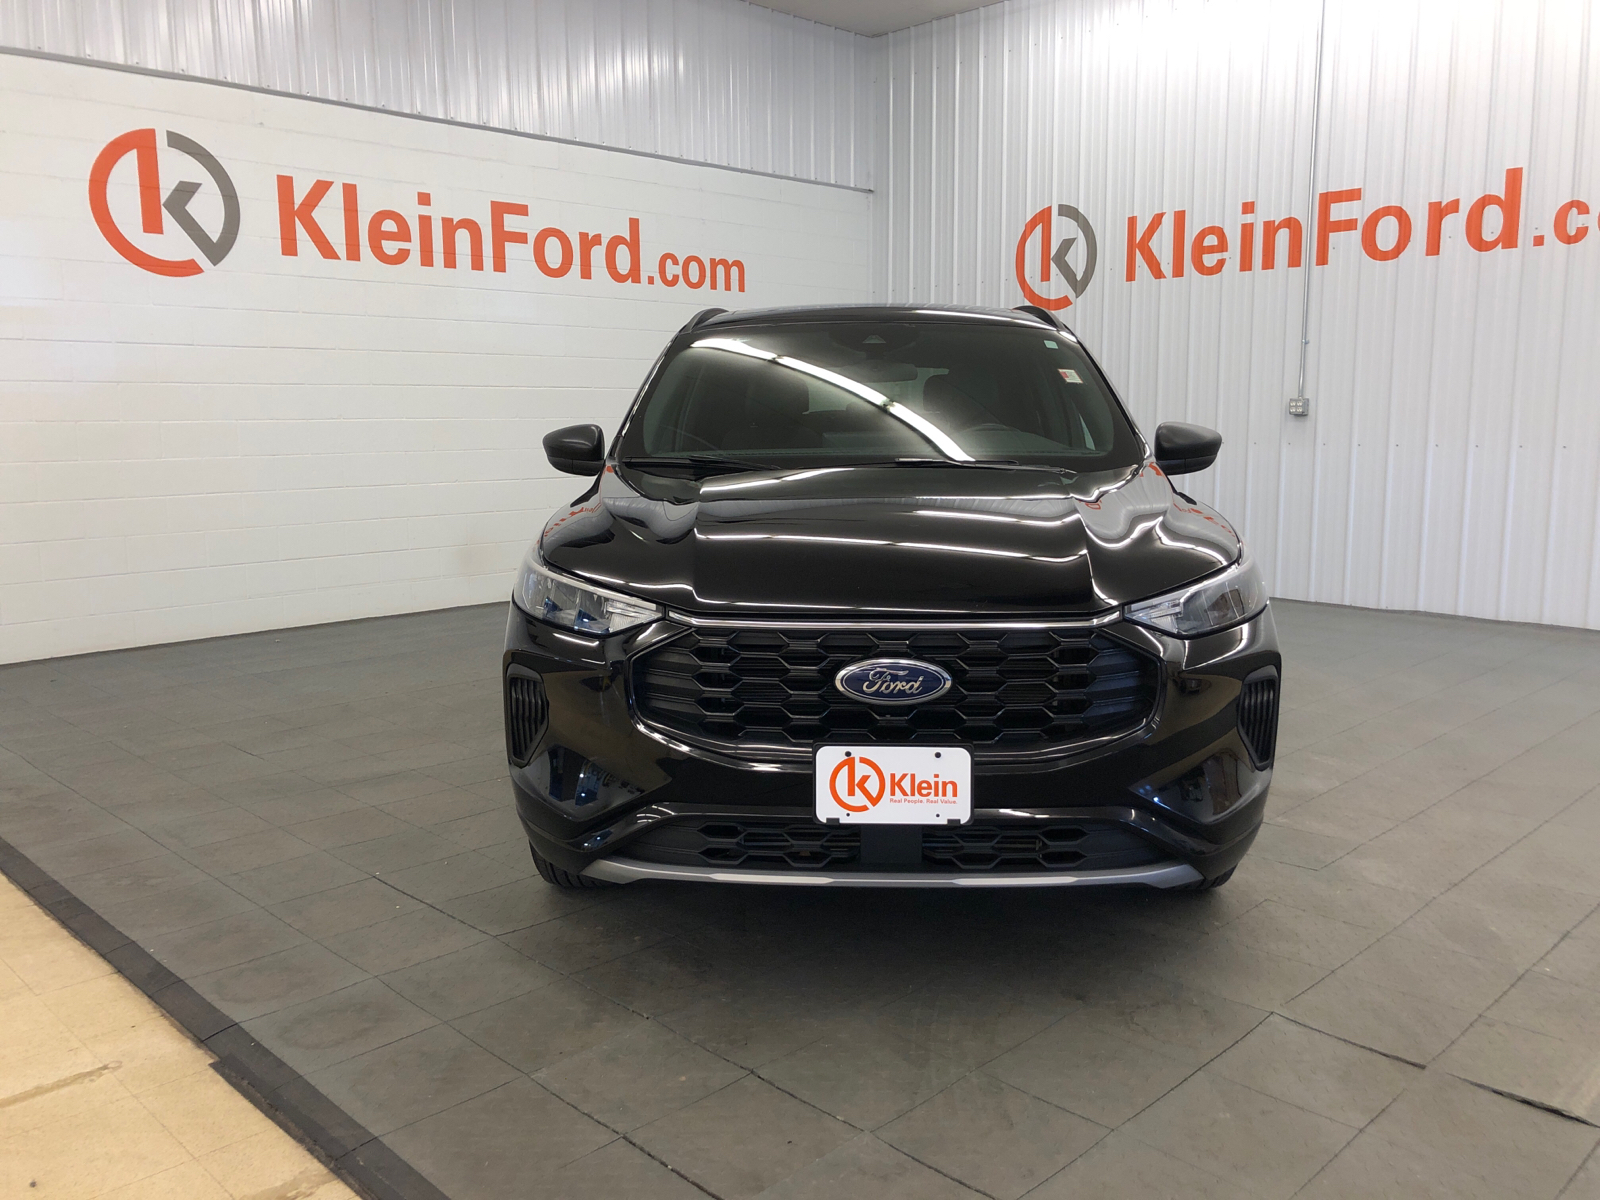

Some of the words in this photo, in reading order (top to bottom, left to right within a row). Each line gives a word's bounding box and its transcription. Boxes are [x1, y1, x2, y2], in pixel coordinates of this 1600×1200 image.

[275, 174, 746, 293] KleinFord.com
[1124, 166, 1600, 283] KleinFord.c
[863, 668, 924, 694] Ford
[889, 773, 958, 798] Klein
